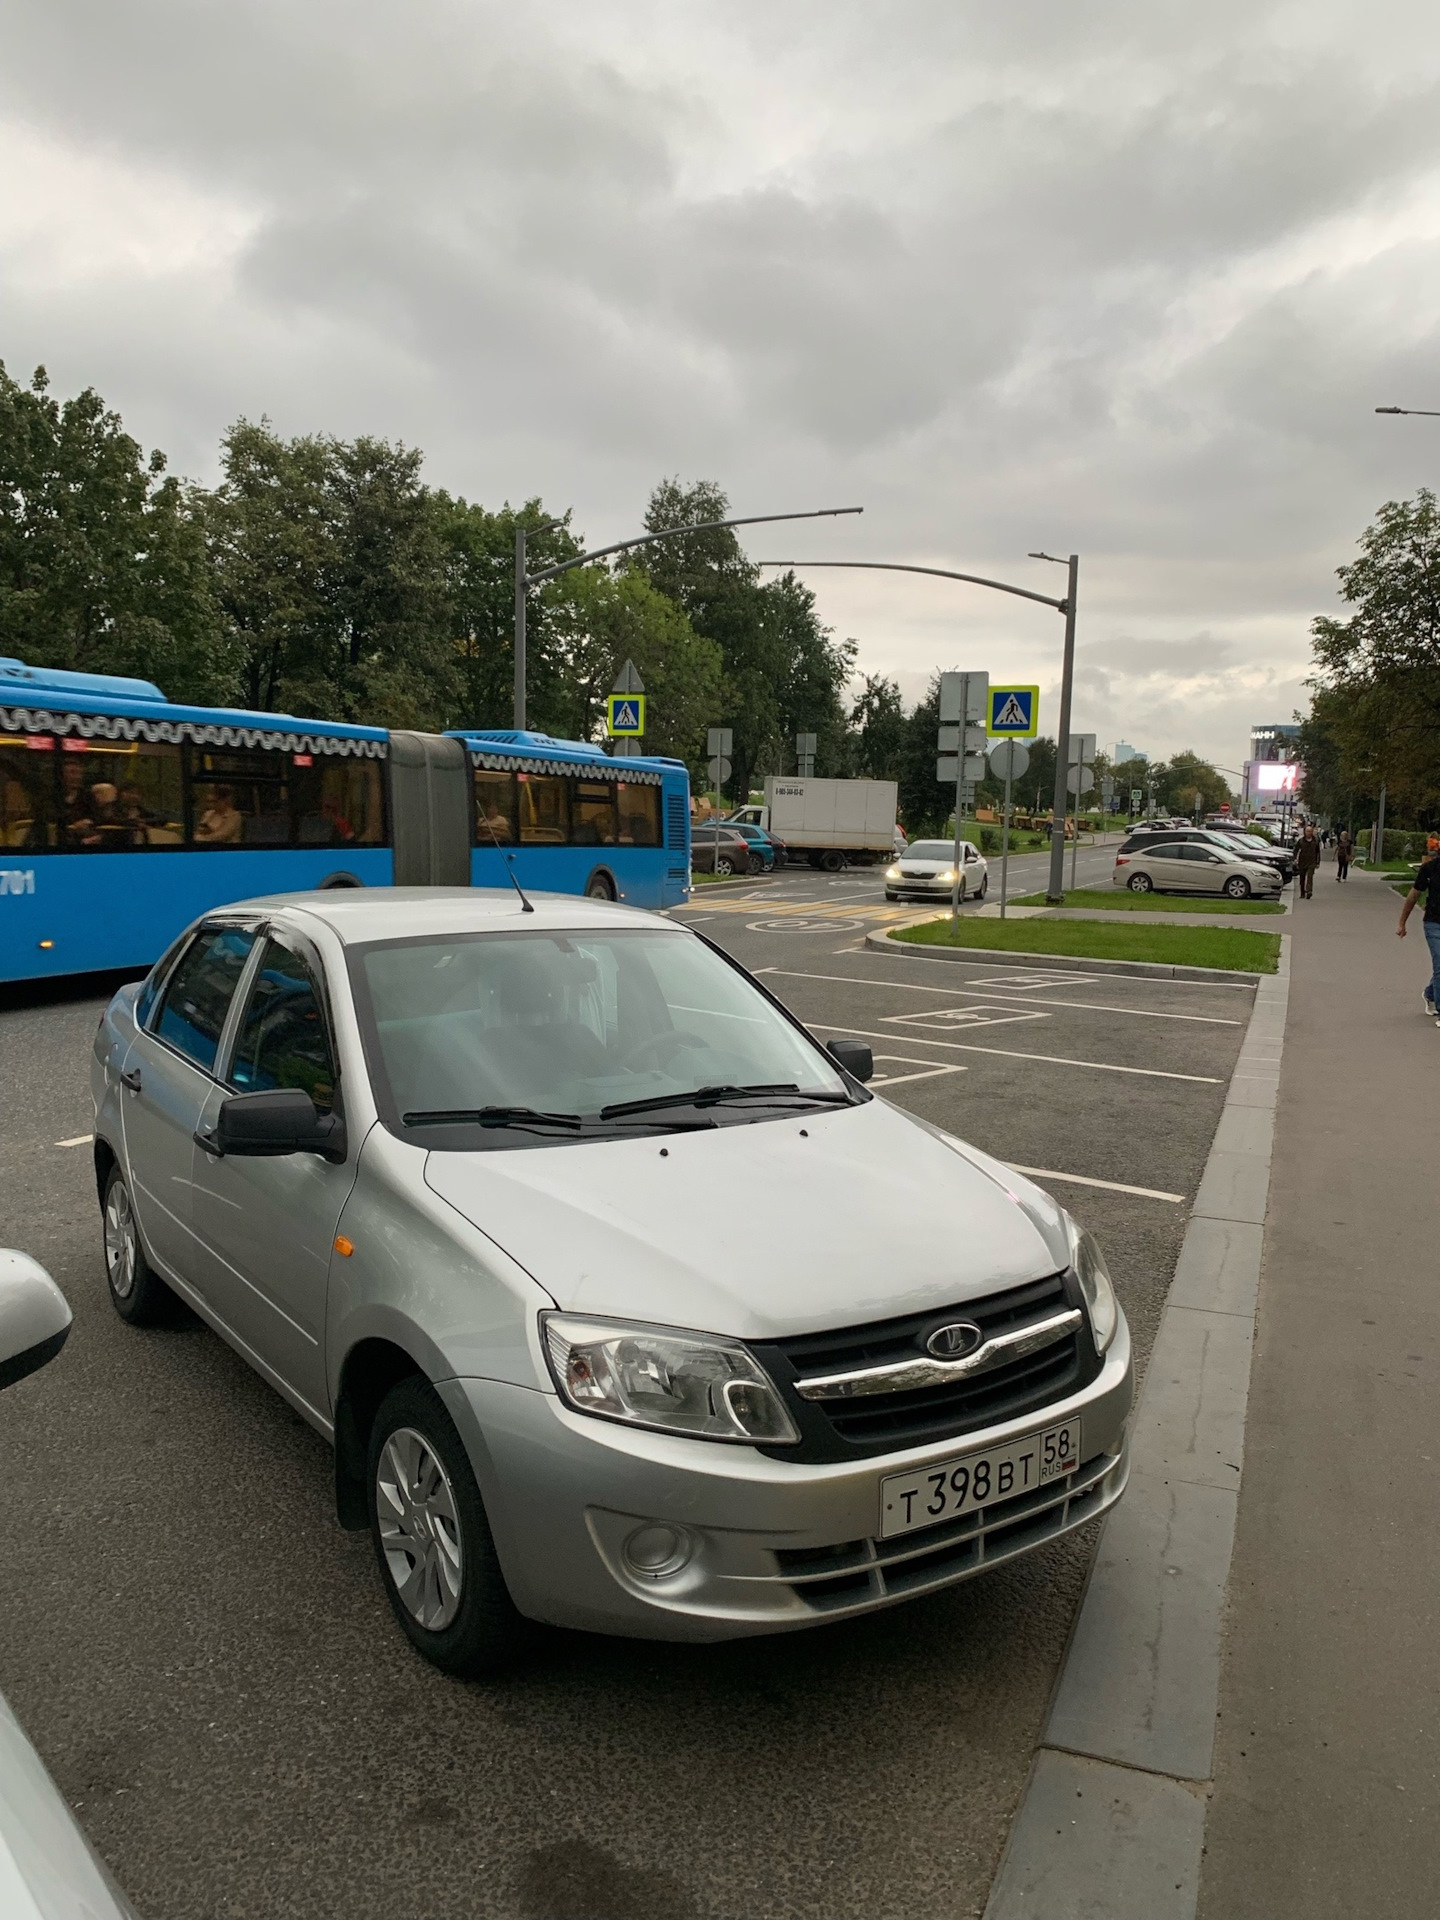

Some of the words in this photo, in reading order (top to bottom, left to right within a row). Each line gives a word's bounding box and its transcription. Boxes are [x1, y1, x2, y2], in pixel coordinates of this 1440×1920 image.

[899, 1452, 1034, 1524] Т398ВТ
[1043, 1428, 1070, 1465] 58
[1041, 1461, 1062, 1479] RUS
